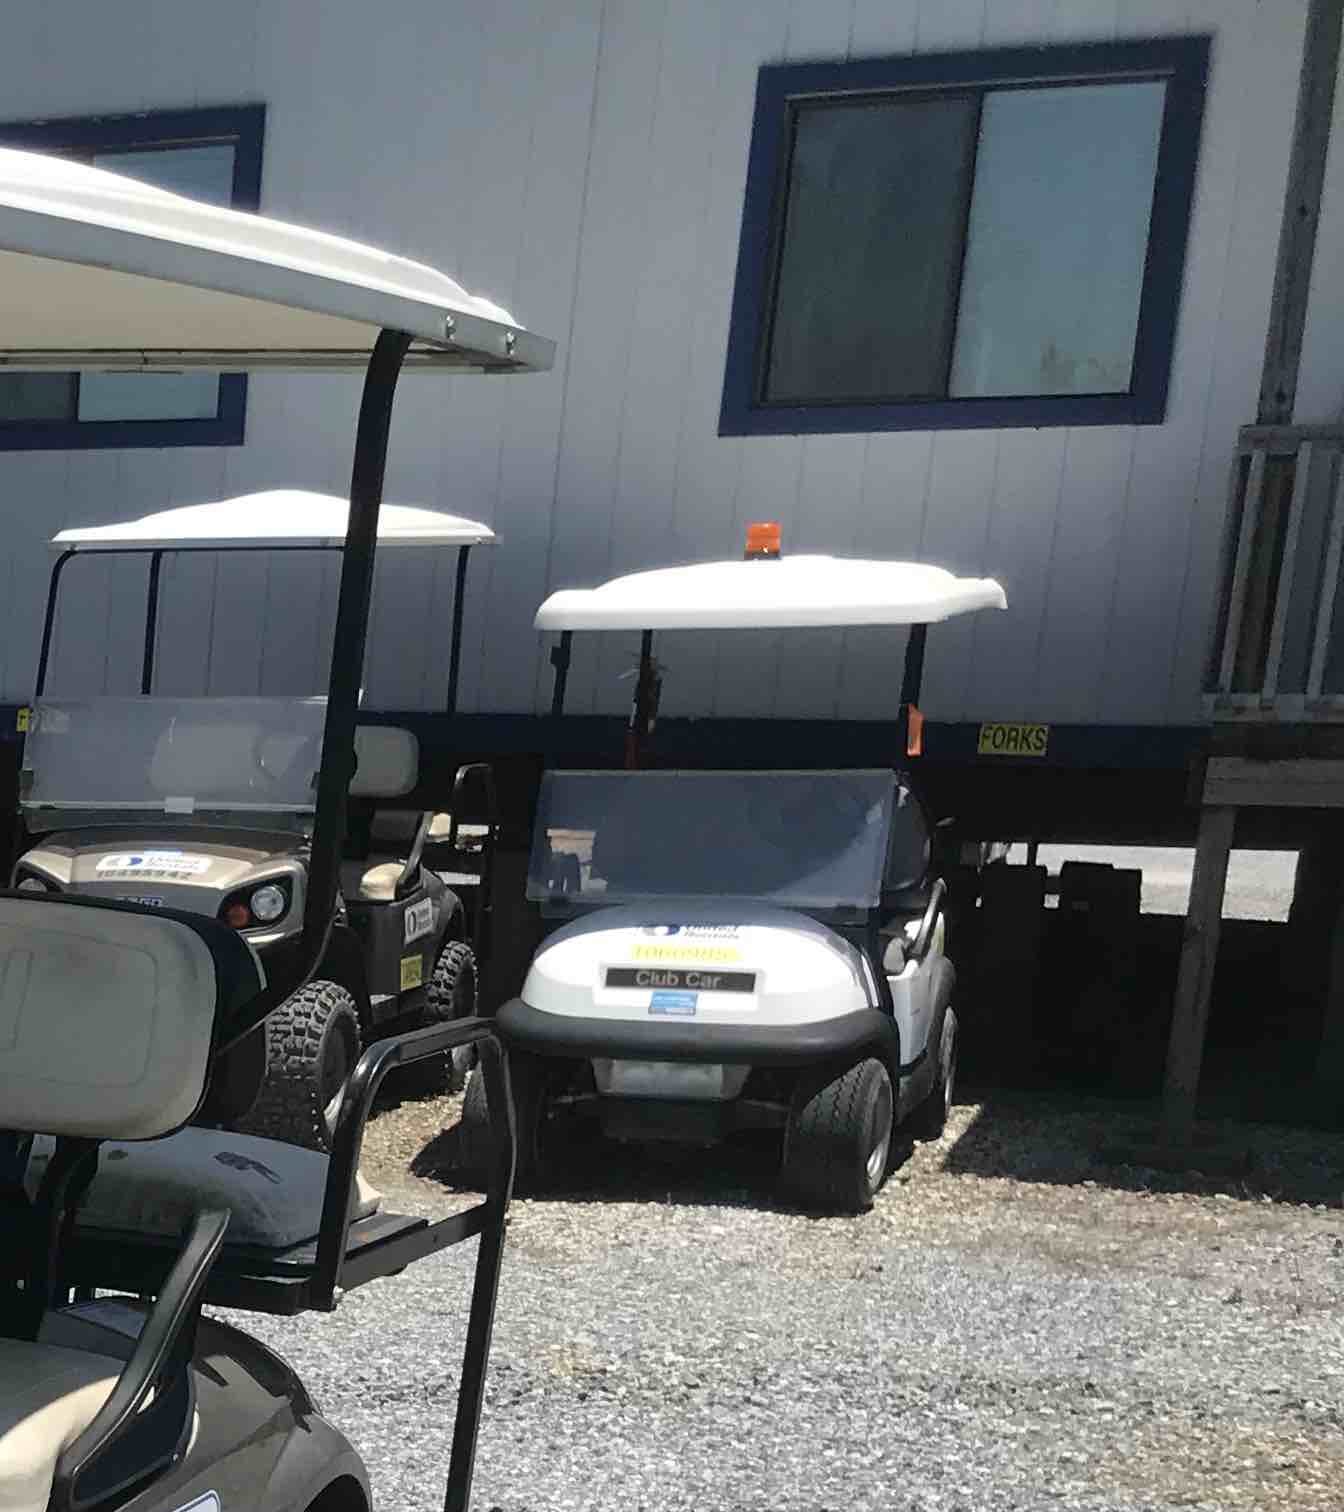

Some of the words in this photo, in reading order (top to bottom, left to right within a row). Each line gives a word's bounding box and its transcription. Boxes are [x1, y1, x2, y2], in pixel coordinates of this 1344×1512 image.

[980, 726, 1046, 752] FORKS
[635, 970, 679, 986] Club
[685, 972, 723, 989] Car
